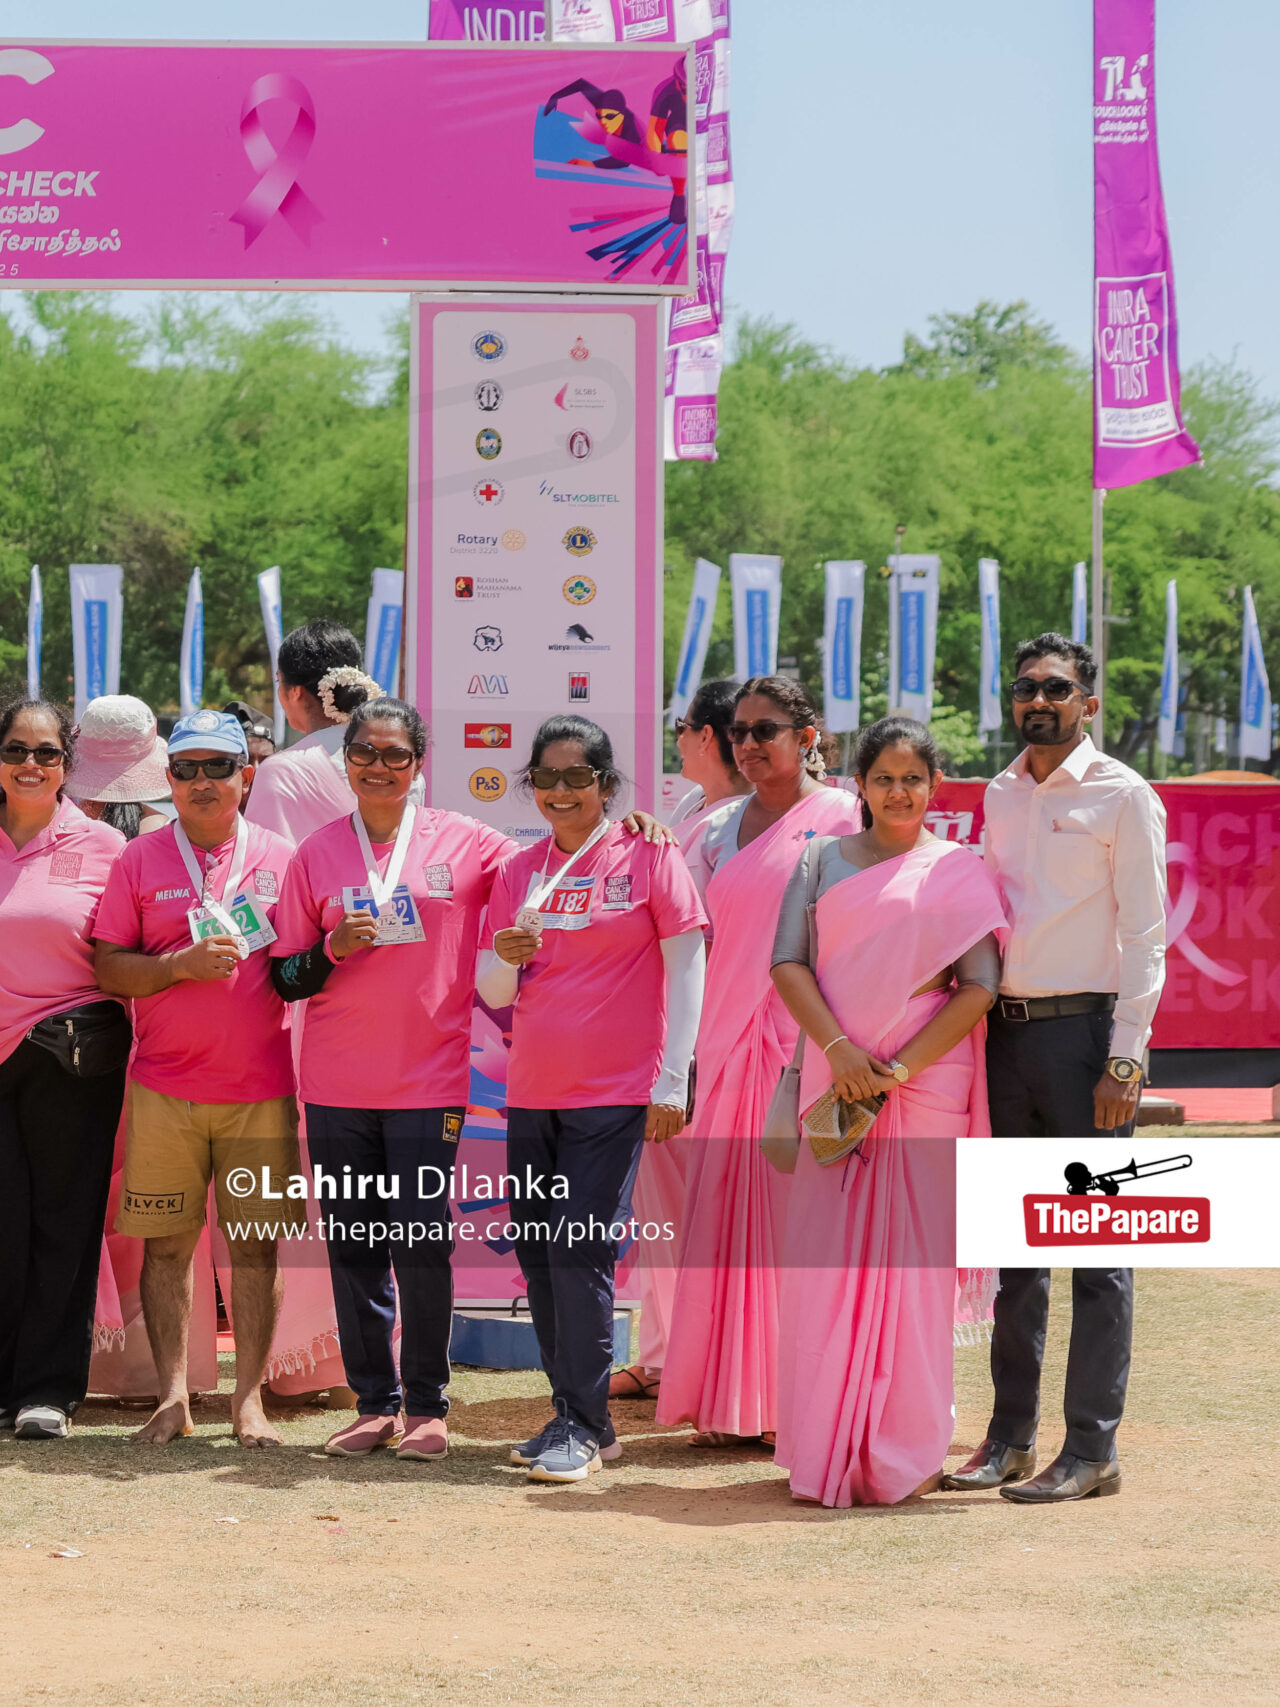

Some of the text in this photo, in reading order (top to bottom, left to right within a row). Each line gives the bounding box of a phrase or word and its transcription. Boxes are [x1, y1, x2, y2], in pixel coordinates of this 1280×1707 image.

[457, 533, 498, 546] Rotary
[476, 776, 500, 791] P&S
[155, 888, 191, 902] MELWA
[545, 891, 588, 913] 1182
